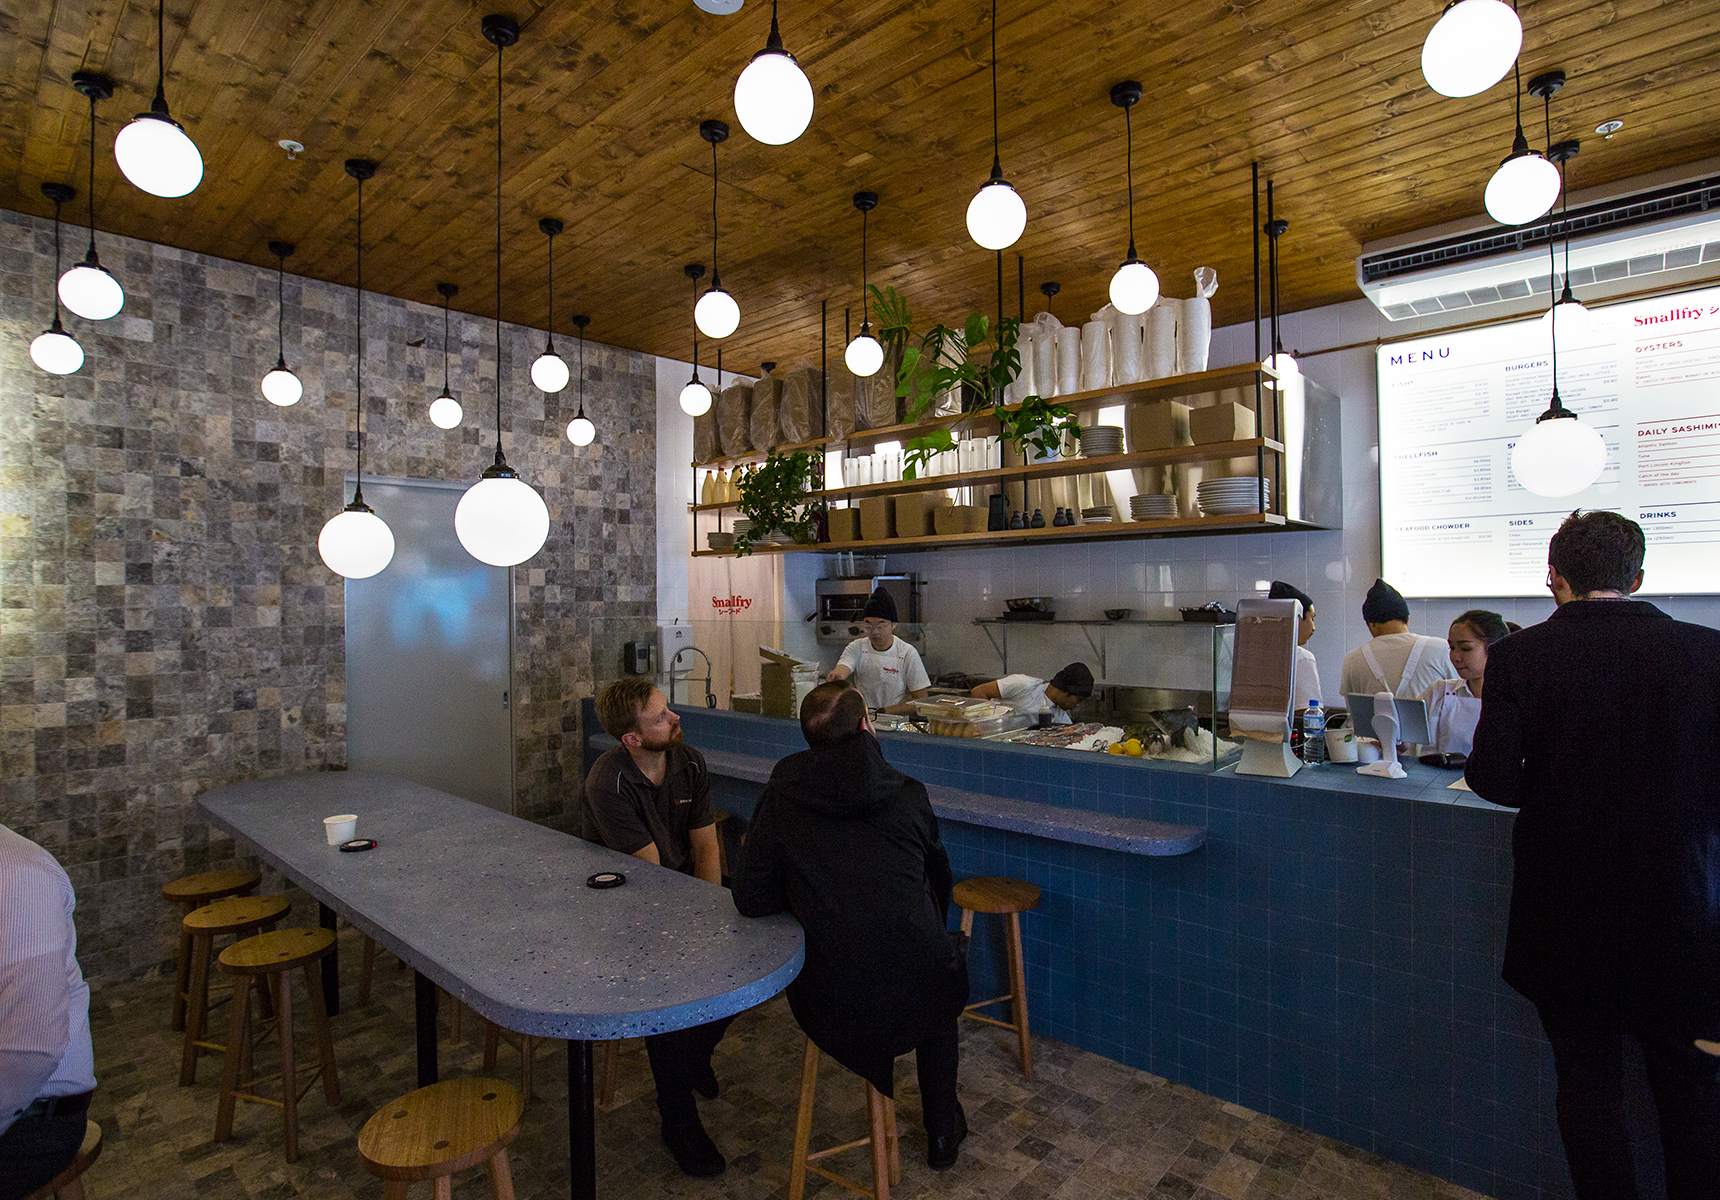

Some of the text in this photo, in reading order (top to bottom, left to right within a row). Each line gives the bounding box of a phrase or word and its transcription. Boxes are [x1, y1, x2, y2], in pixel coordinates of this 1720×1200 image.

[1634, 306, 1703, 327] Smallfry
[1635, 340, 1683, 353] OYSTERS
[1390, 346, 1450, 366] MENU
[1505, 360, 1549, 372] BURGERS
[1637, 427, 1668, 437] DAILY
[1394, 450, 1438, 460] SHELLFISH
[1639, 511, 1677, 519] DRINKS
[1395, 522, 1470, 533] SEAFOOD CHOWDER
[1508, 519, 1534, 527] SIDES
[712, 595, 752, 609] Smalfry
